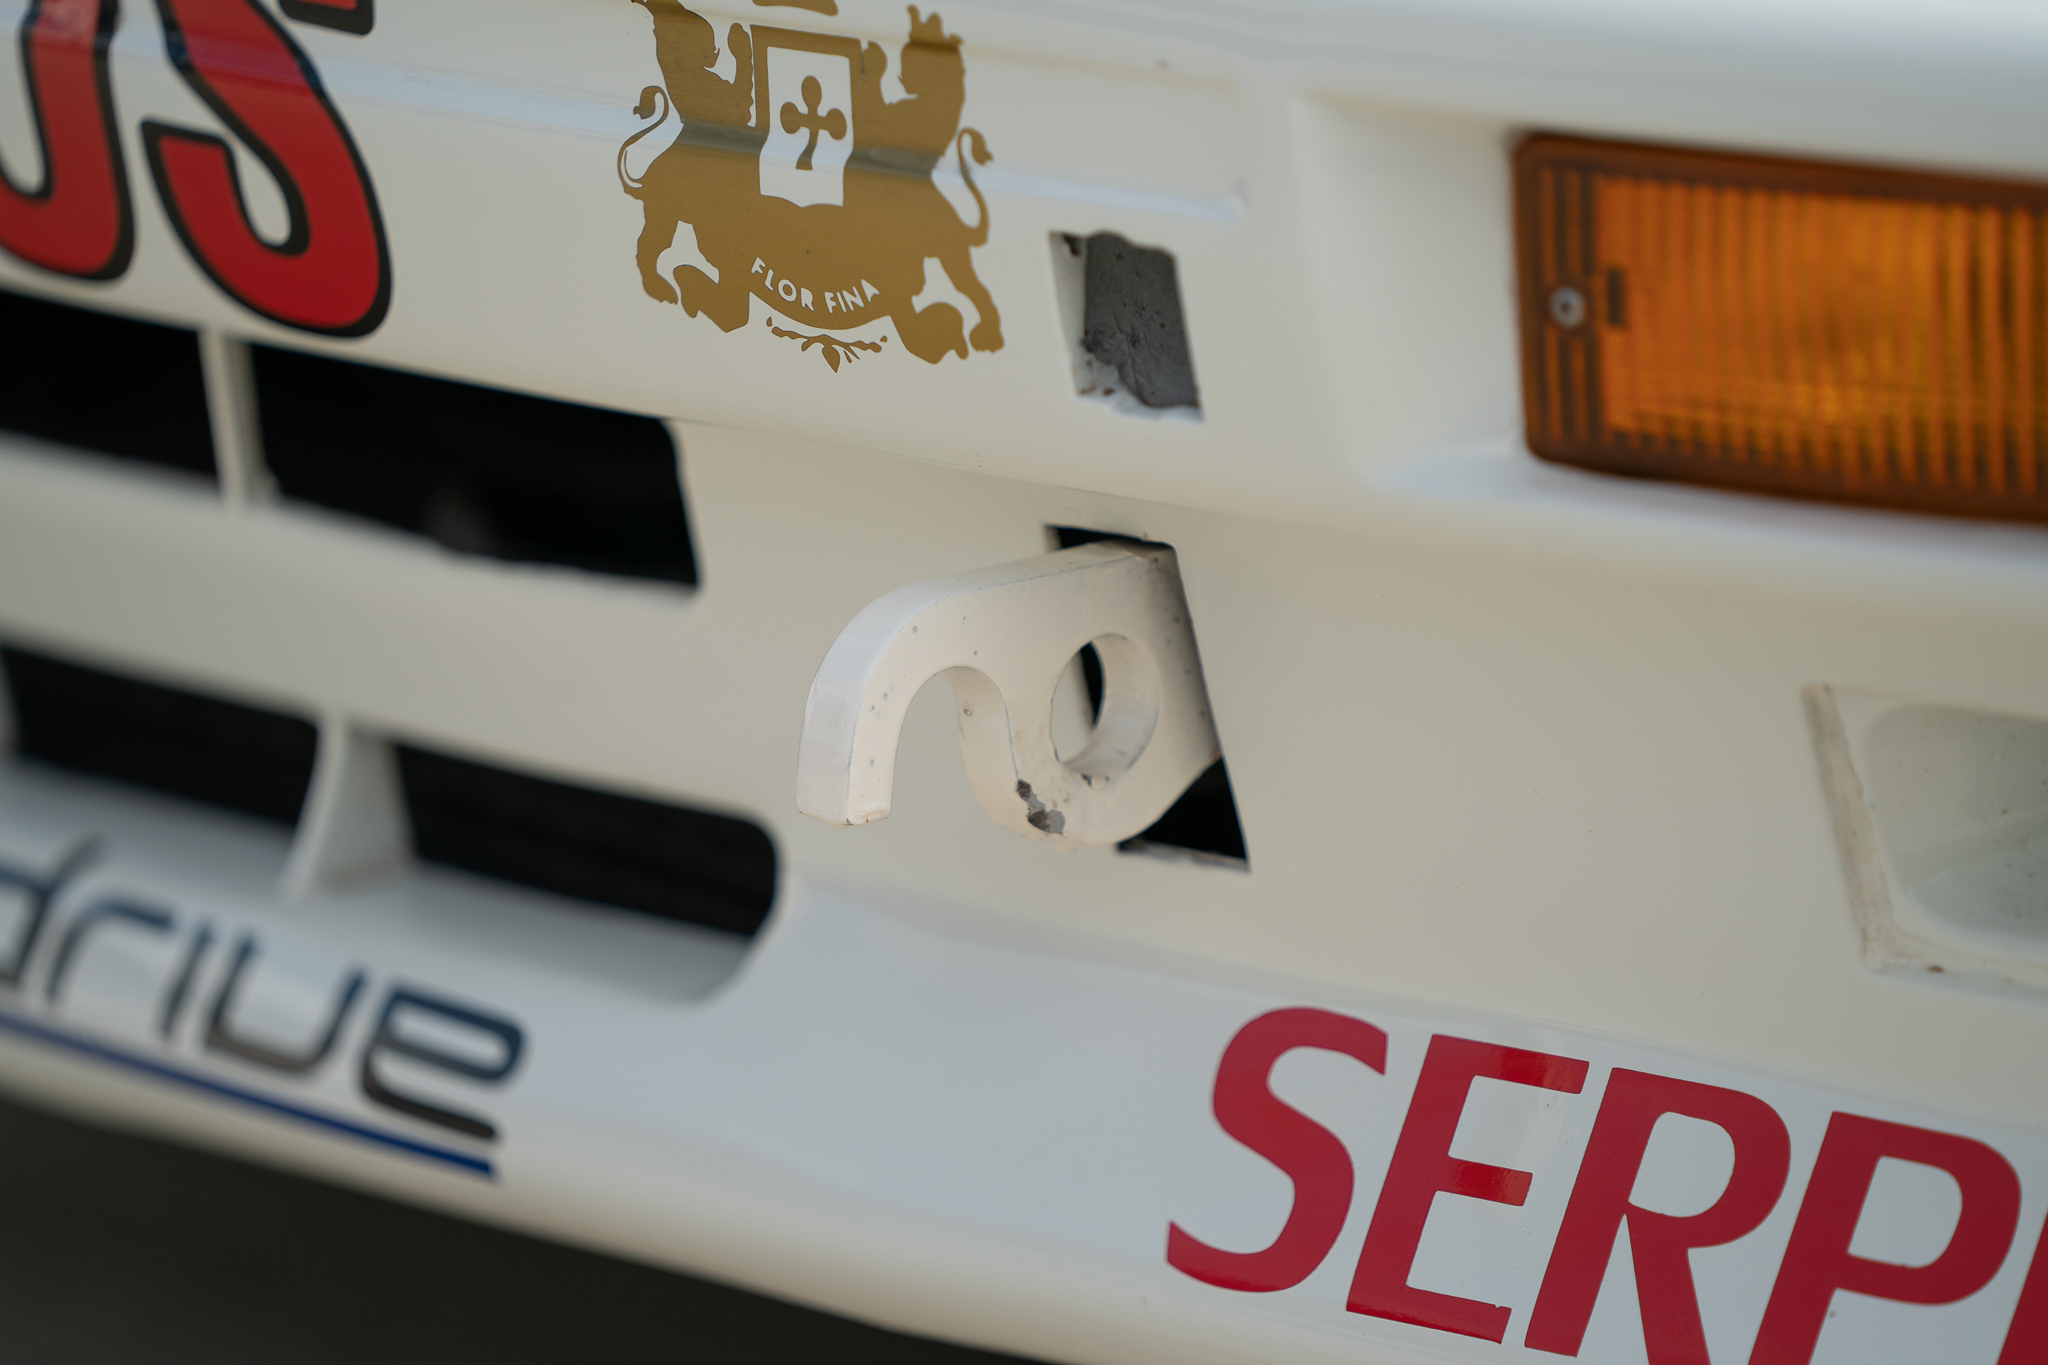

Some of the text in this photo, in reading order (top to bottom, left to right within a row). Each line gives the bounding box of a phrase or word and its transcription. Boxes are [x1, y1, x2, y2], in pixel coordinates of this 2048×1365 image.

[751, 256, 880, 314] FLOR FINA
[1167, 1007, 2048, 1365] SERP
